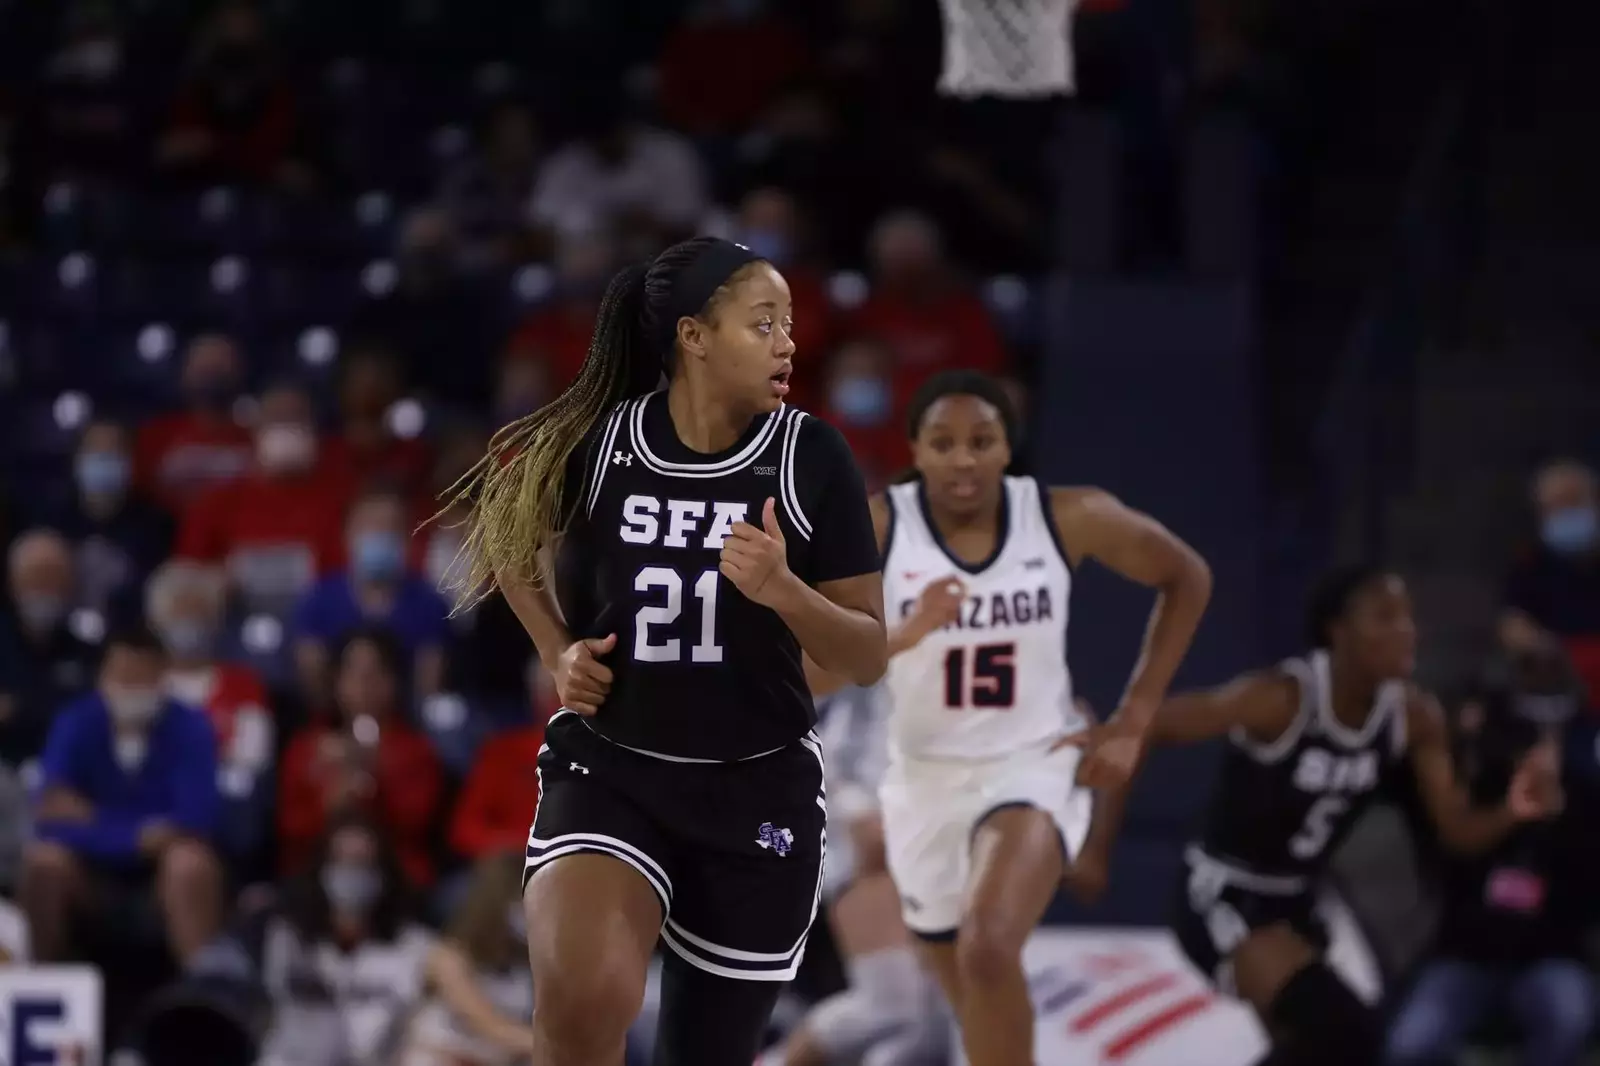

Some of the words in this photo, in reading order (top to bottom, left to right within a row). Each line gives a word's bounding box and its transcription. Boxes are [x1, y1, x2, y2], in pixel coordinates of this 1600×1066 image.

[753, 466, 777, 476] WAC
[619, 494, 748, 549] SFA
[633, 566, 724, 663] 21
[900, 586, 1053, 631] ZAGA
[944, 641, 1017, 708] 15
[758, 822, 792, 852] SFA
